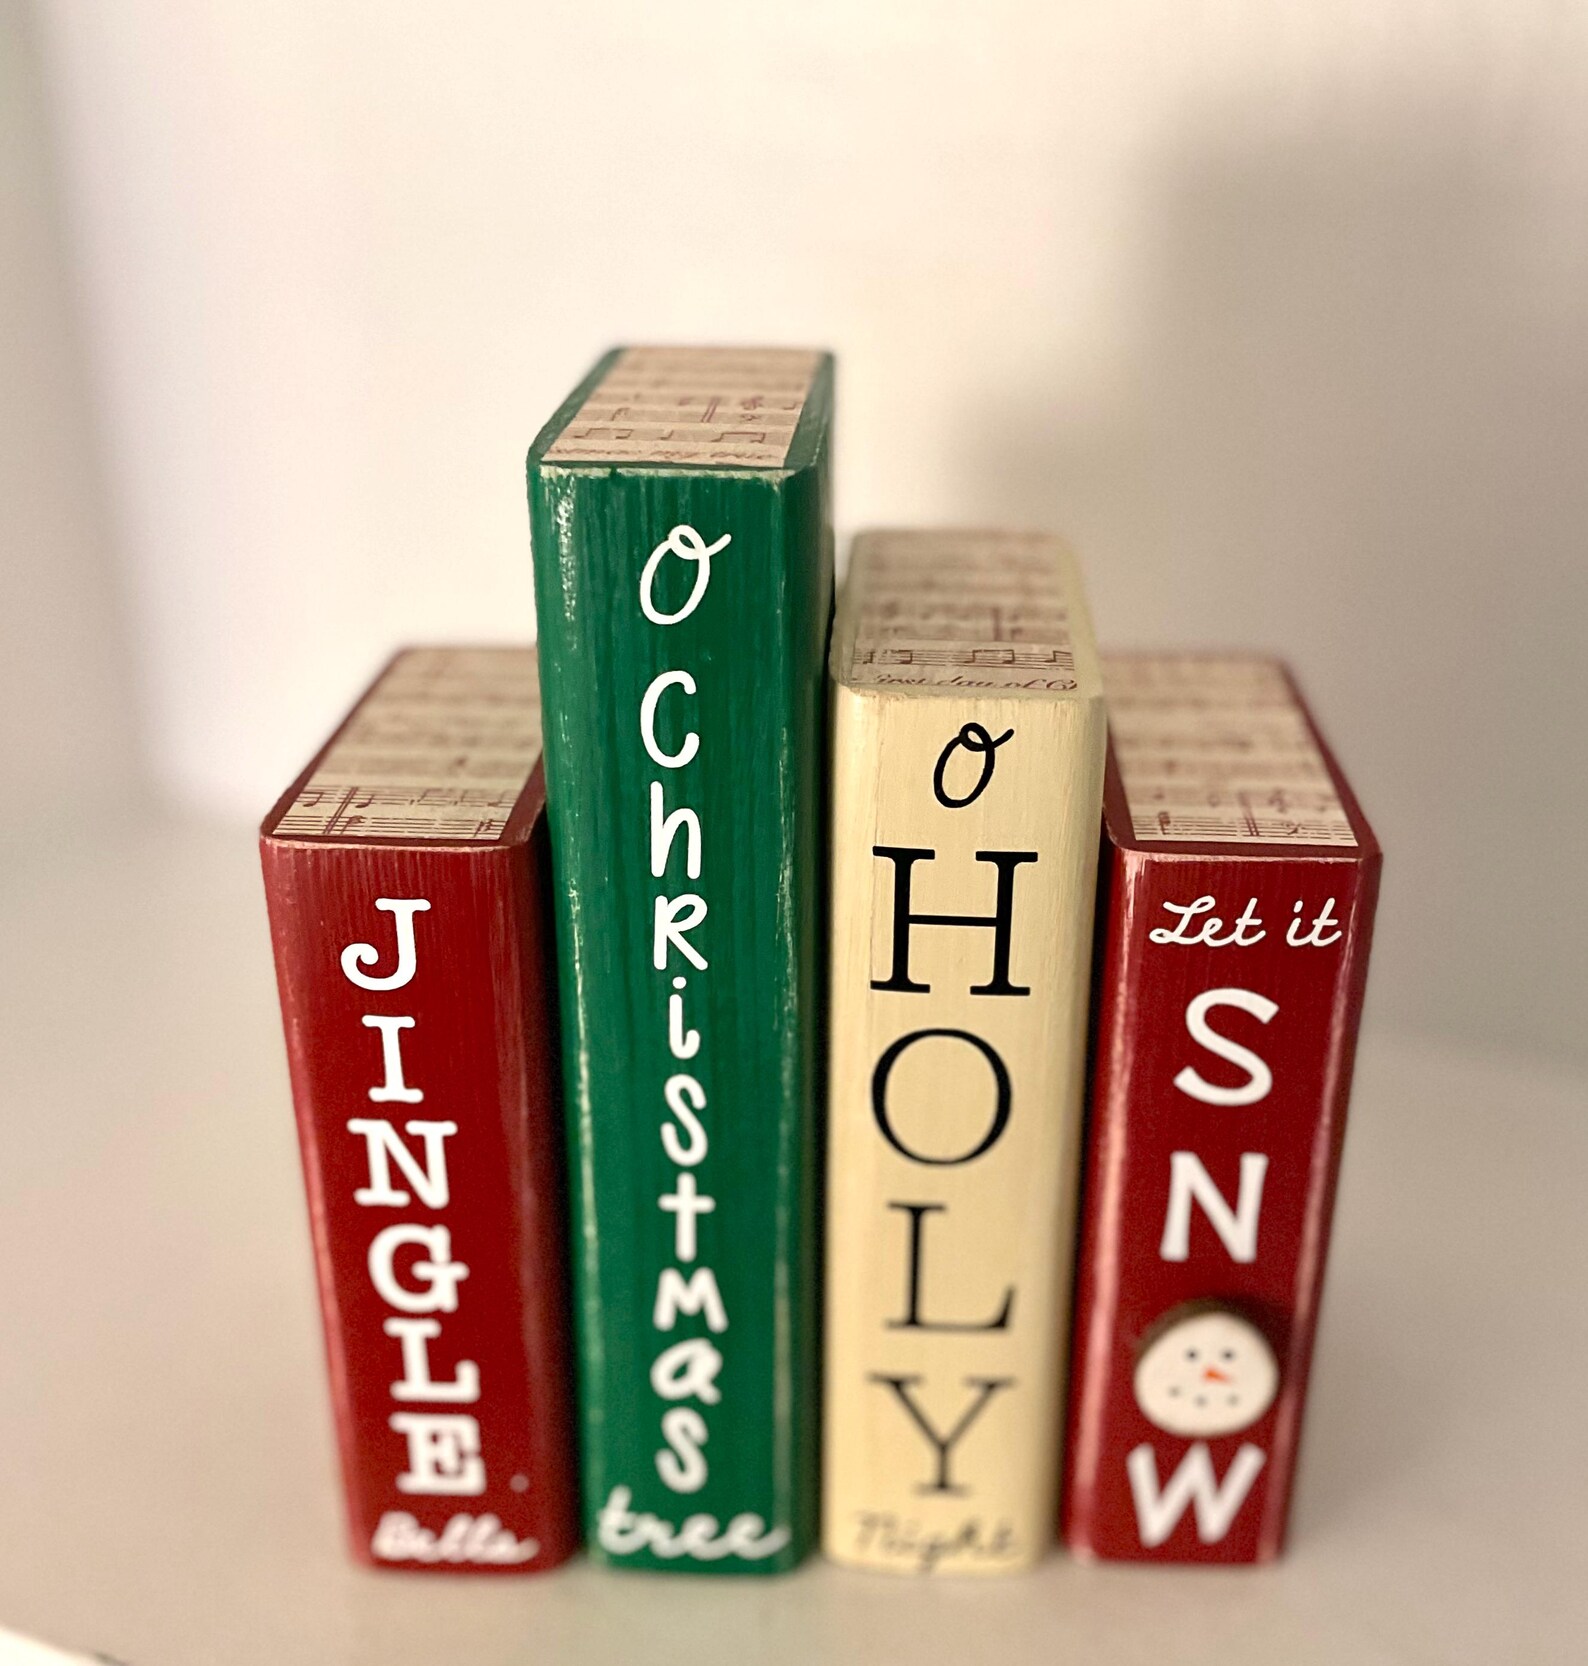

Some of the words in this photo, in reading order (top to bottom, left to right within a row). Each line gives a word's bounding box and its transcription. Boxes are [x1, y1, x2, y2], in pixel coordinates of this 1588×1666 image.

[640, 524, 731, 625] O
[933, 722, 1015, 809] O
[1149, 895, 1266, 947] Let
[1286, 897, 1343, 947] it
[340, 897, 485, 1496] JINGLE
[869, 845, 1039, 1496] HOLY
[371, 1511, 540, 1563] Bells
[599, 1485, 790, 1560] tree
